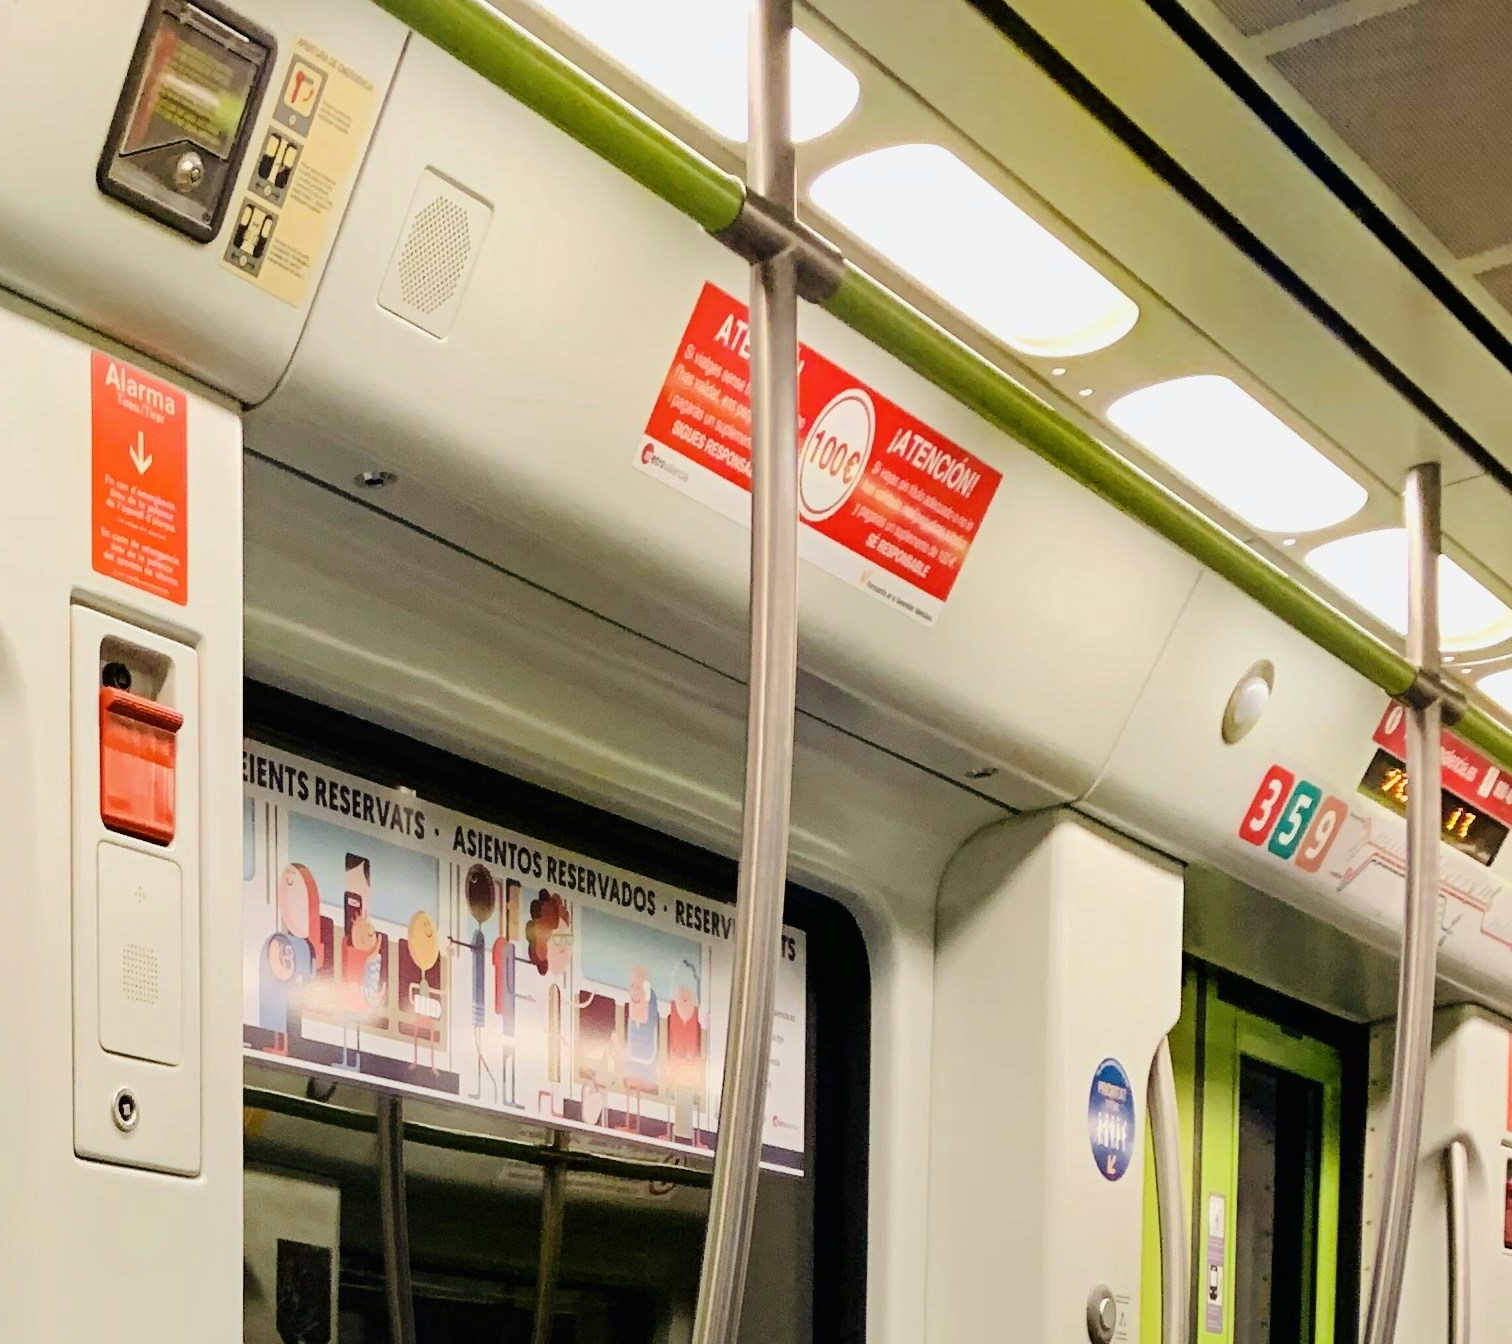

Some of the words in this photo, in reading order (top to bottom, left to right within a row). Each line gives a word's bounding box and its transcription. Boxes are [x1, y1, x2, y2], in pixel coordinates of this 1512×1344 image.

[105, 362, 176, 416] Alarma
[886, 427, 981, 499] ¡ATENCIÓN!
[243, 751, 310, 801] EIENTS
[315, 775, 426, 840] RESERVATS
[452, 825, 542, 879] ASIENTOS
[546, 855, 656, 916] RESERVADOS
[1249, 778, 1283, 832] 3
[1278, 793, 1313, 846] 5
[1304, 809, 1337, 860] 9
